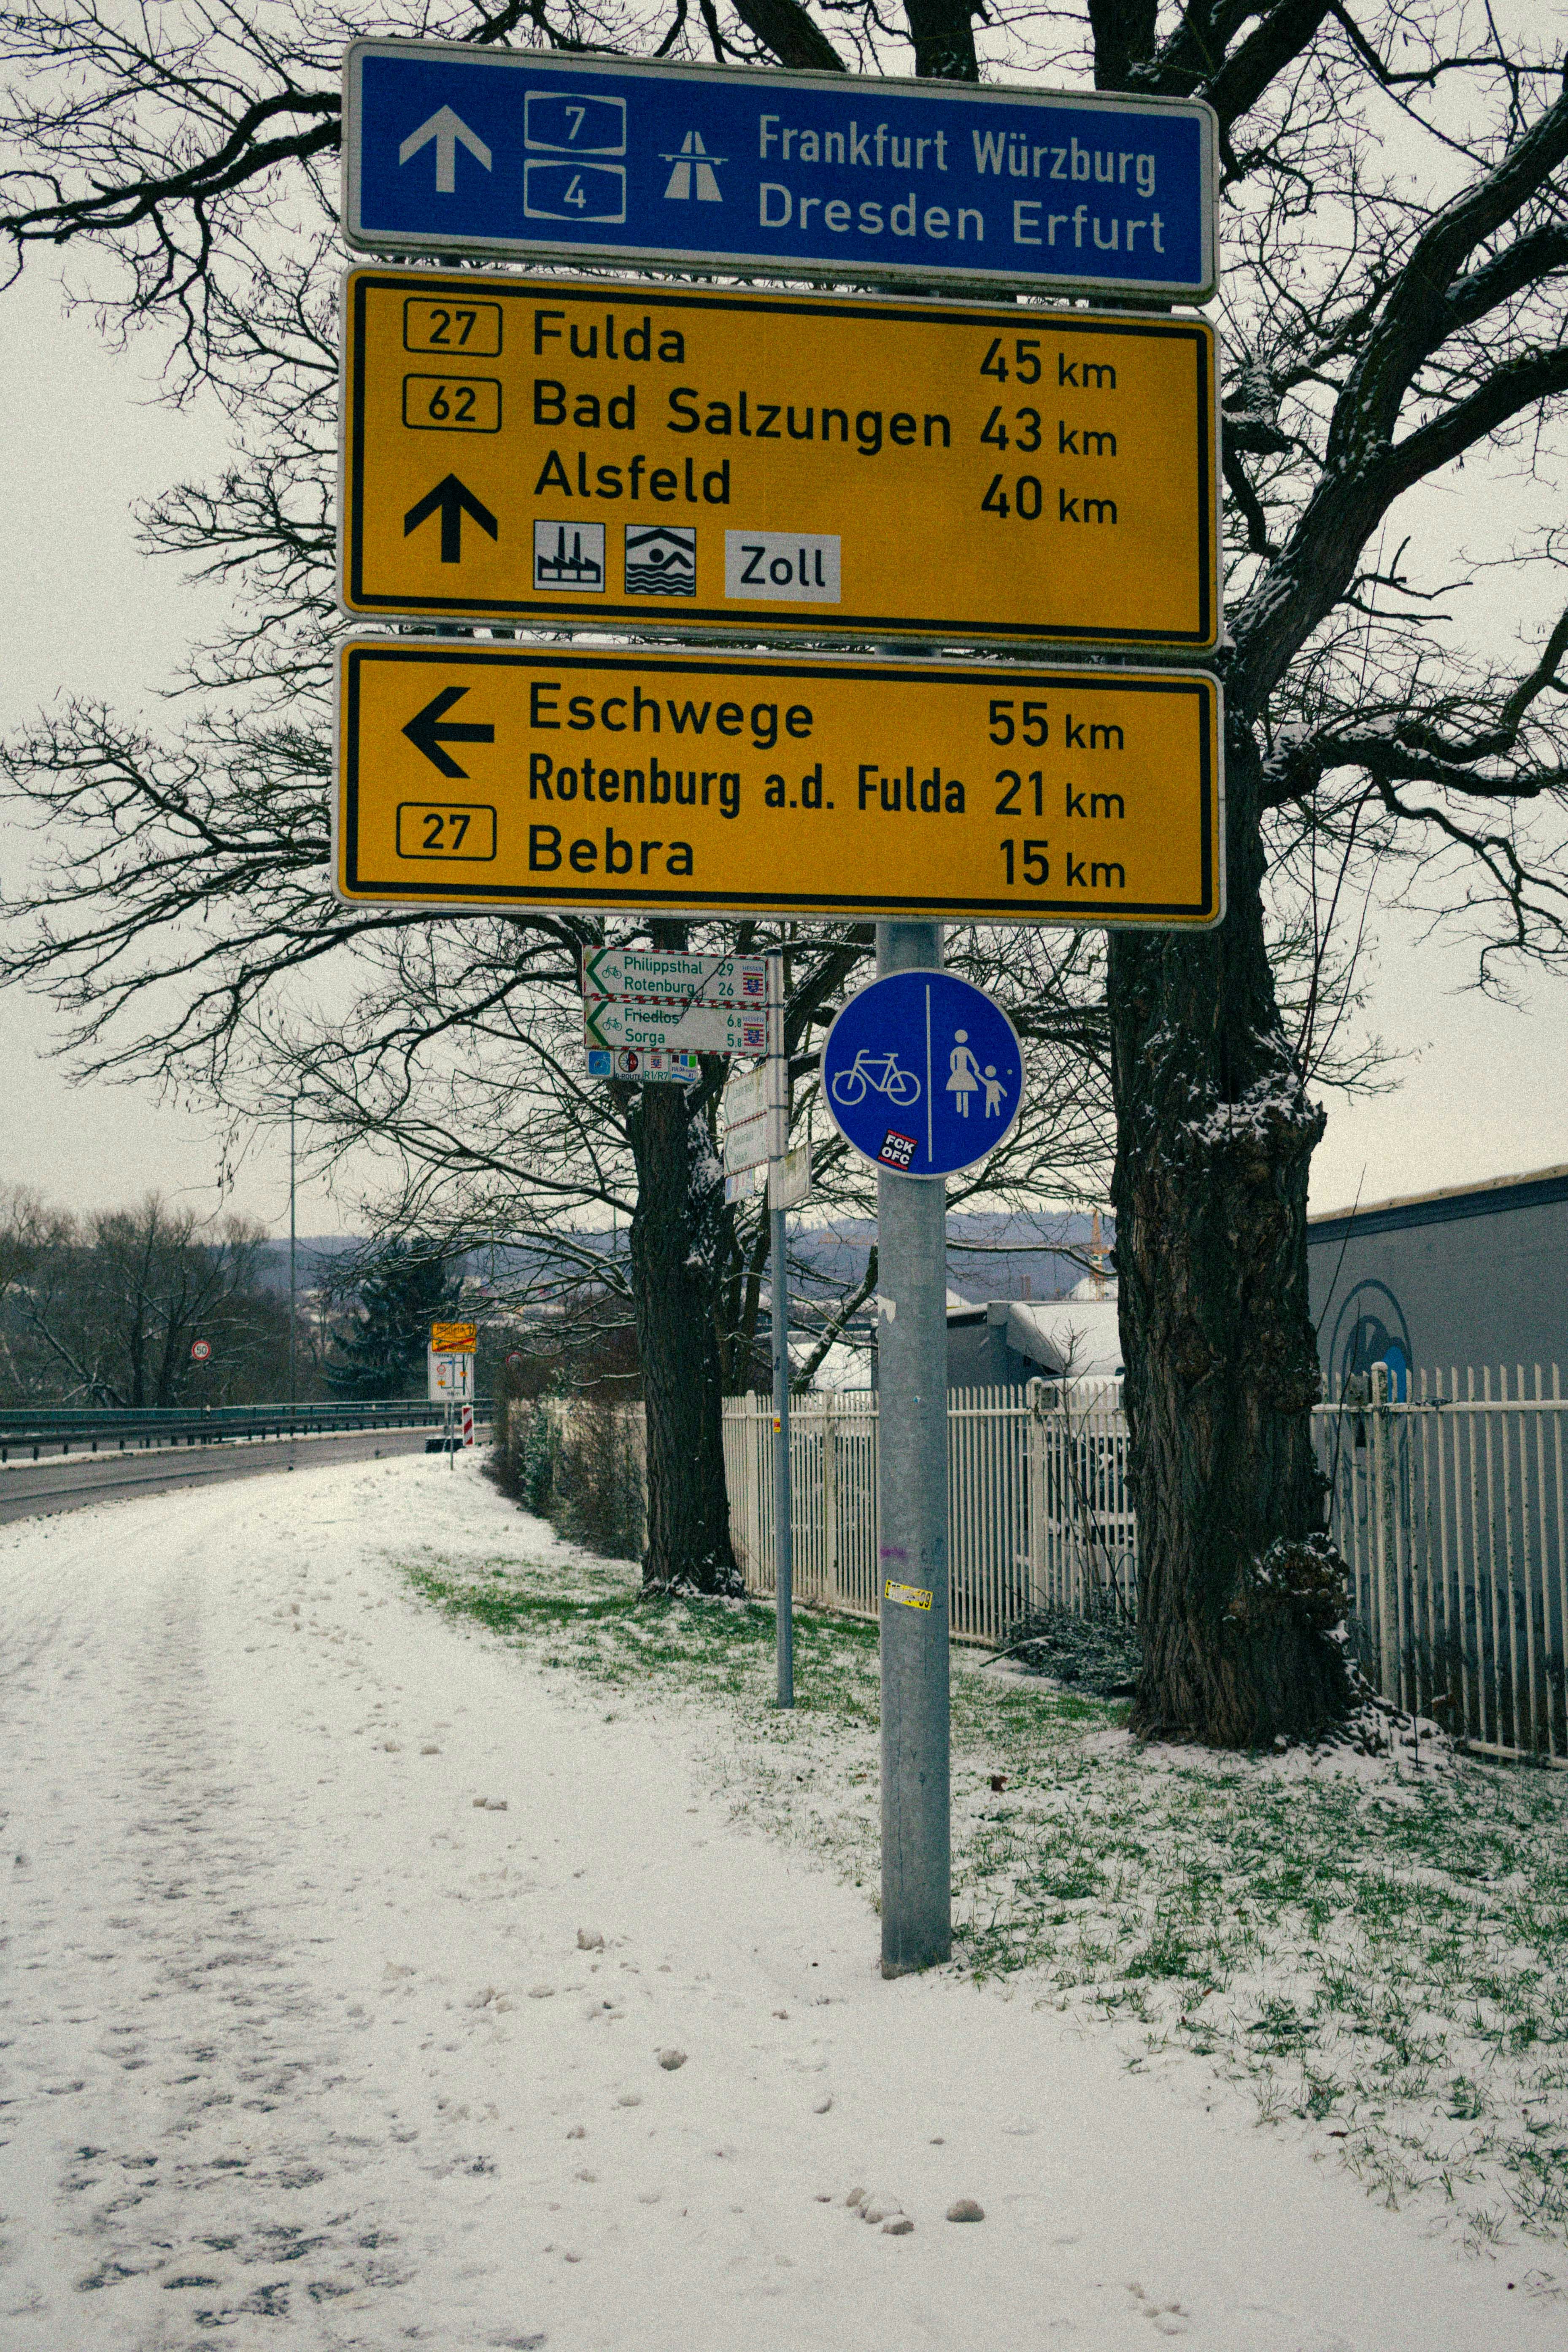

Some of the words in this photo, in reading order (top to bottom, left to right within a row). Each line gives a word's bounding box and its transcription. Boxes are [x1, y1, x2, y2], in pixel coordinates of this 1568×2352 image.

[564, 108, 586, 140] 7
[759, 115, 947, 172] Frankfurt
[972, 129, 1156, 197] Würzburg
[563, 175, 586, 209] 4
[759, 183, 985, 241] Dresden
[1013, 201, 1166, 254] Erfurt
[429, 310, 476, 346] 27
[534, 310, 685, 364] Fulda
[980, 338, 1041, 385] 45
[1058, 353, 1117, 389] km
[429, 386, 476, 422] 62
[534, 379, 636, 430] Bad
[667, 388, 950, 456] Salzungen
[980, 406, 1042, 453] 43
[1059, 420, 1117, 456] km
[534, 450, 730, 504] Alsfeld
[981, 474, 1042, 520] 40
[1059, 488, 1118, 524] km
[740, 546, 825, 587] Zoll
[529, 682, 813, 750] Eschwege
[989, 701, 1048, 747] 55
[1065, 714, 1124, 750] km
[529, 753, 740, 819] Rotenburg
[765, 763, 834, 809] a.d.
[858, 765, 965, 814] Fulda
[995, 769, 1042, 816] 21
[1066, 783, 1125, 819] km
[422, 814, 471, 850] 27
[529, 825, 694, 876] Bebra
[1000, 839, 1049, 885] 15
[1066, 853, 1125, 887] km
[624, 957, 702, 975] Philippsthal
[719, 963, 733, 976] 29
[625, 977, 695, 995] Rotenburg
[718, 983, 733, 996] 26
[625, 1009, 679, 1024] Friedlos
[727, 1015, 741, 1028] 6.8
[625, 1029, 665, 1046] Sorga
[727, 1034, 742, 1047] 5.8
[644, 1072, 668, 1081] R1/R7
[882, 1147, 910, 1165] OFC
[886, 1134, 915, 1154] FCK
[197, 1346, 206, 1355] 50
